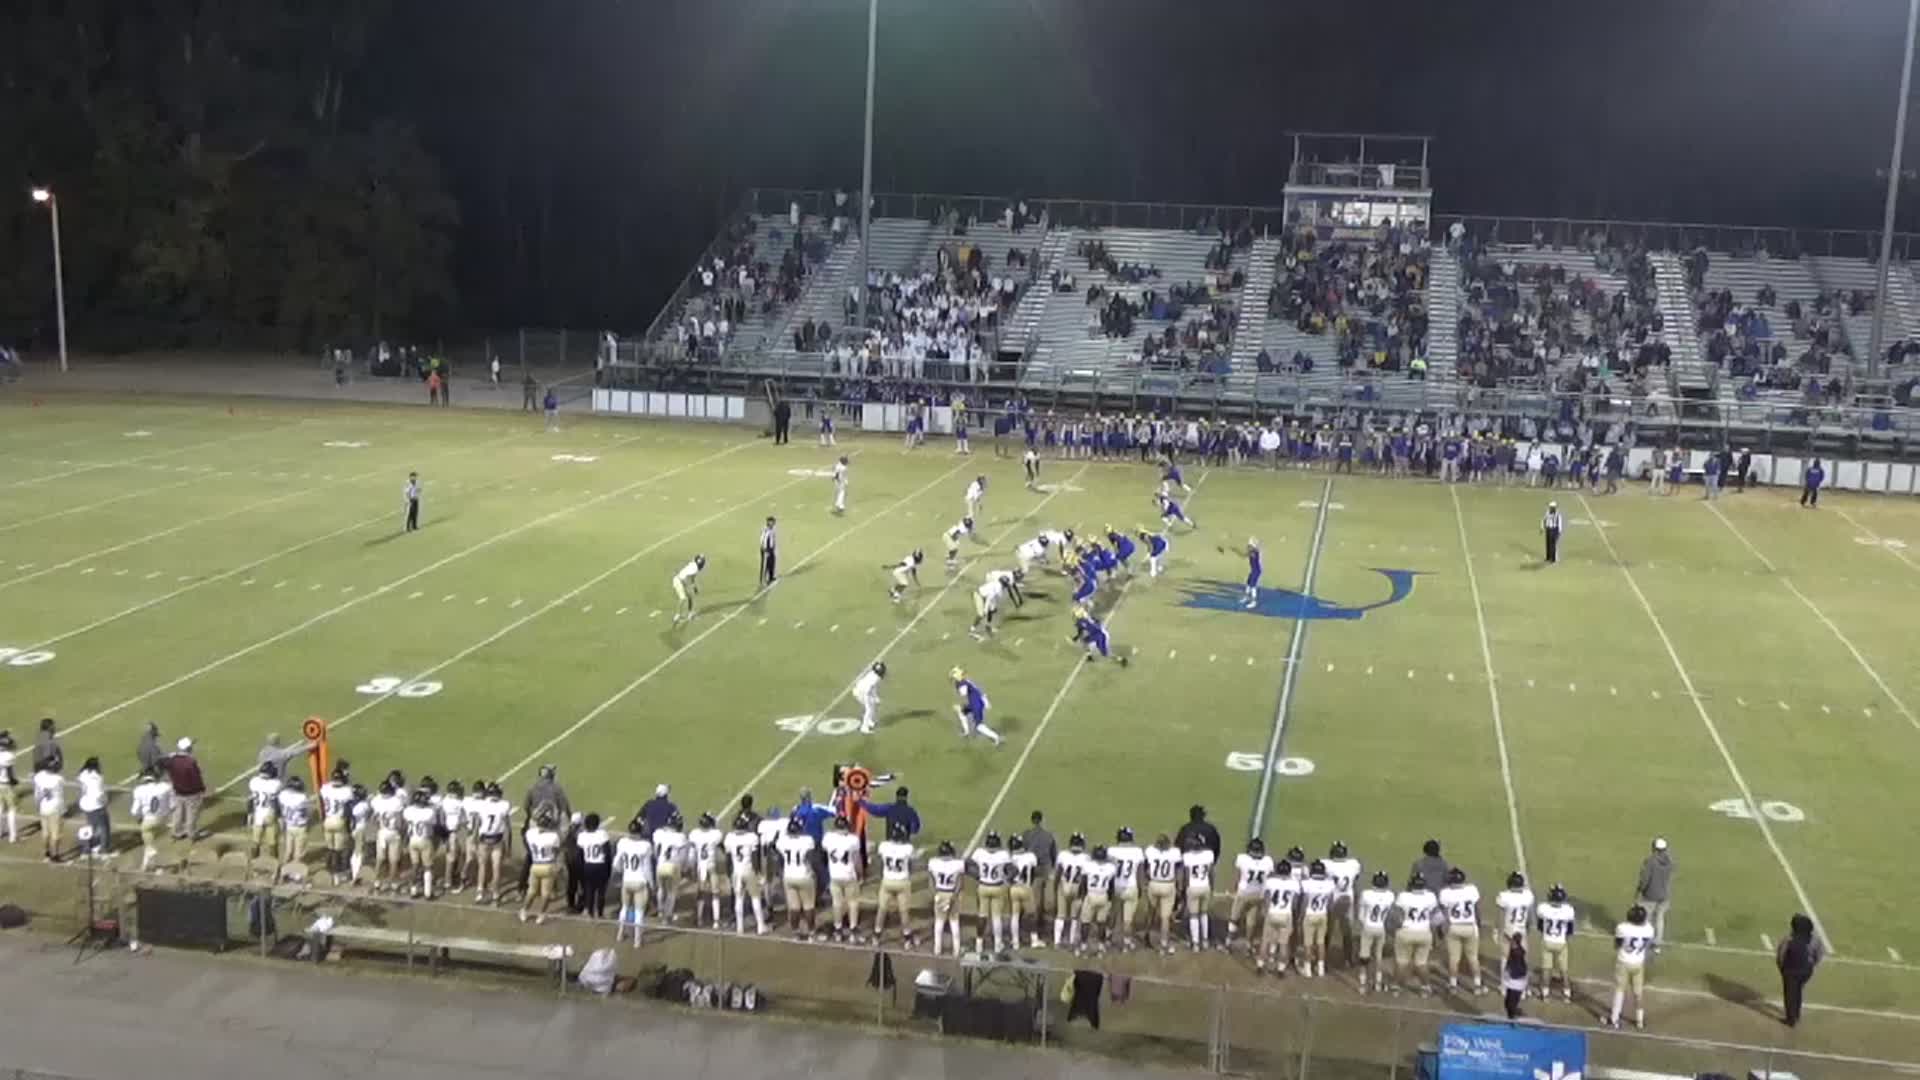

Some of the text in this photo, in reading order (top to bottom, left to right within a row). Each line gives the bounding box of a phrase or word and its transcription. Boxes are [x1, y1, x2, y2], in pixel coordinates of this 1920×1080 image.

[355, 677, 443, 697] 30
[775, 714, 861, 735] 40
[1225, 752, 1314, 775] 50
[1708, 798, 1804, 821] 40
[1451, 900, 1473, 919] 65
